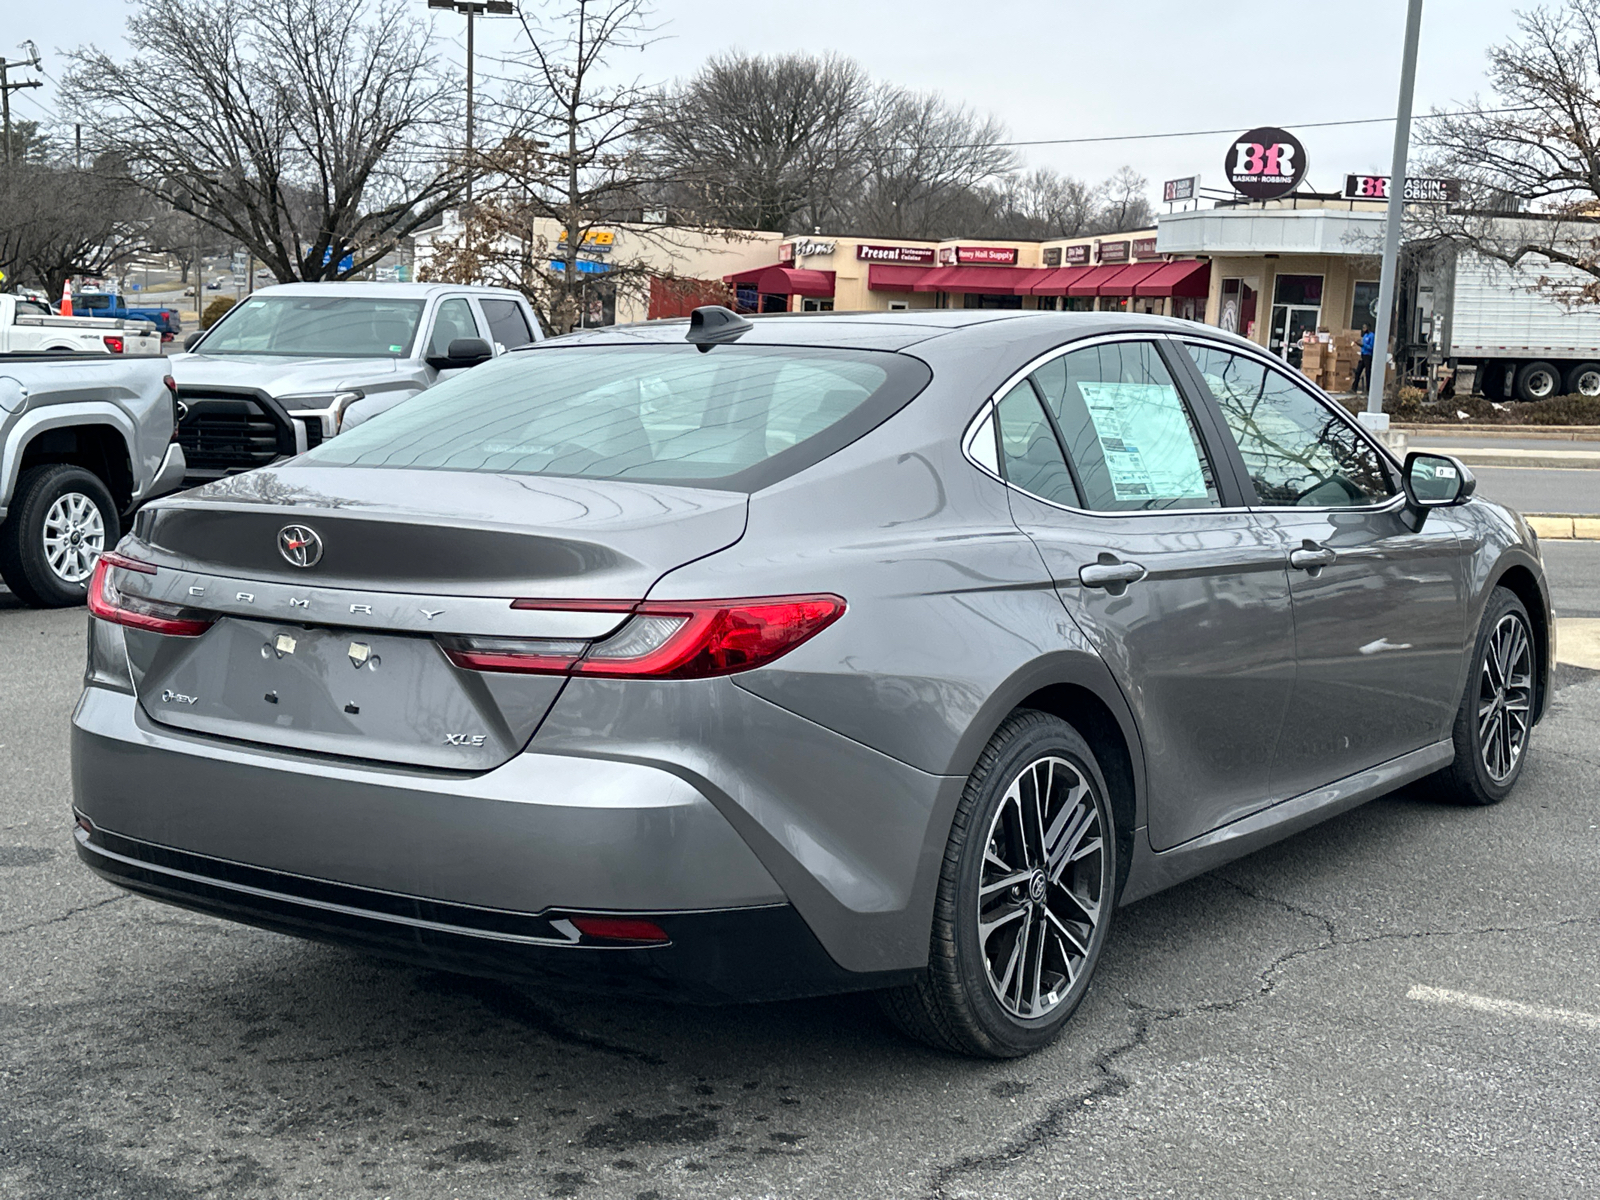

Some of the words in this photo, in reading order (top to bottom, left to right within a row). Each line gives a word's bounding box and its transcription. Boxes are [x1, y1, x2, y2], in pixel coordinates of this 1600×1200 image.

[1232, 175, 1258, 183] BASKIN
[1261, 176, 1293, 184] ROBBINS
[1403, 179, 1441, 190] ASKIN
[1403, 189, 1448, 200] OBBINS
[860, 246, 900, 260] Present
[988, 250, 1014, 261] Supply
[188, 586, 446, 620] CAMRY
[442, 733, 488, 748] XLE
